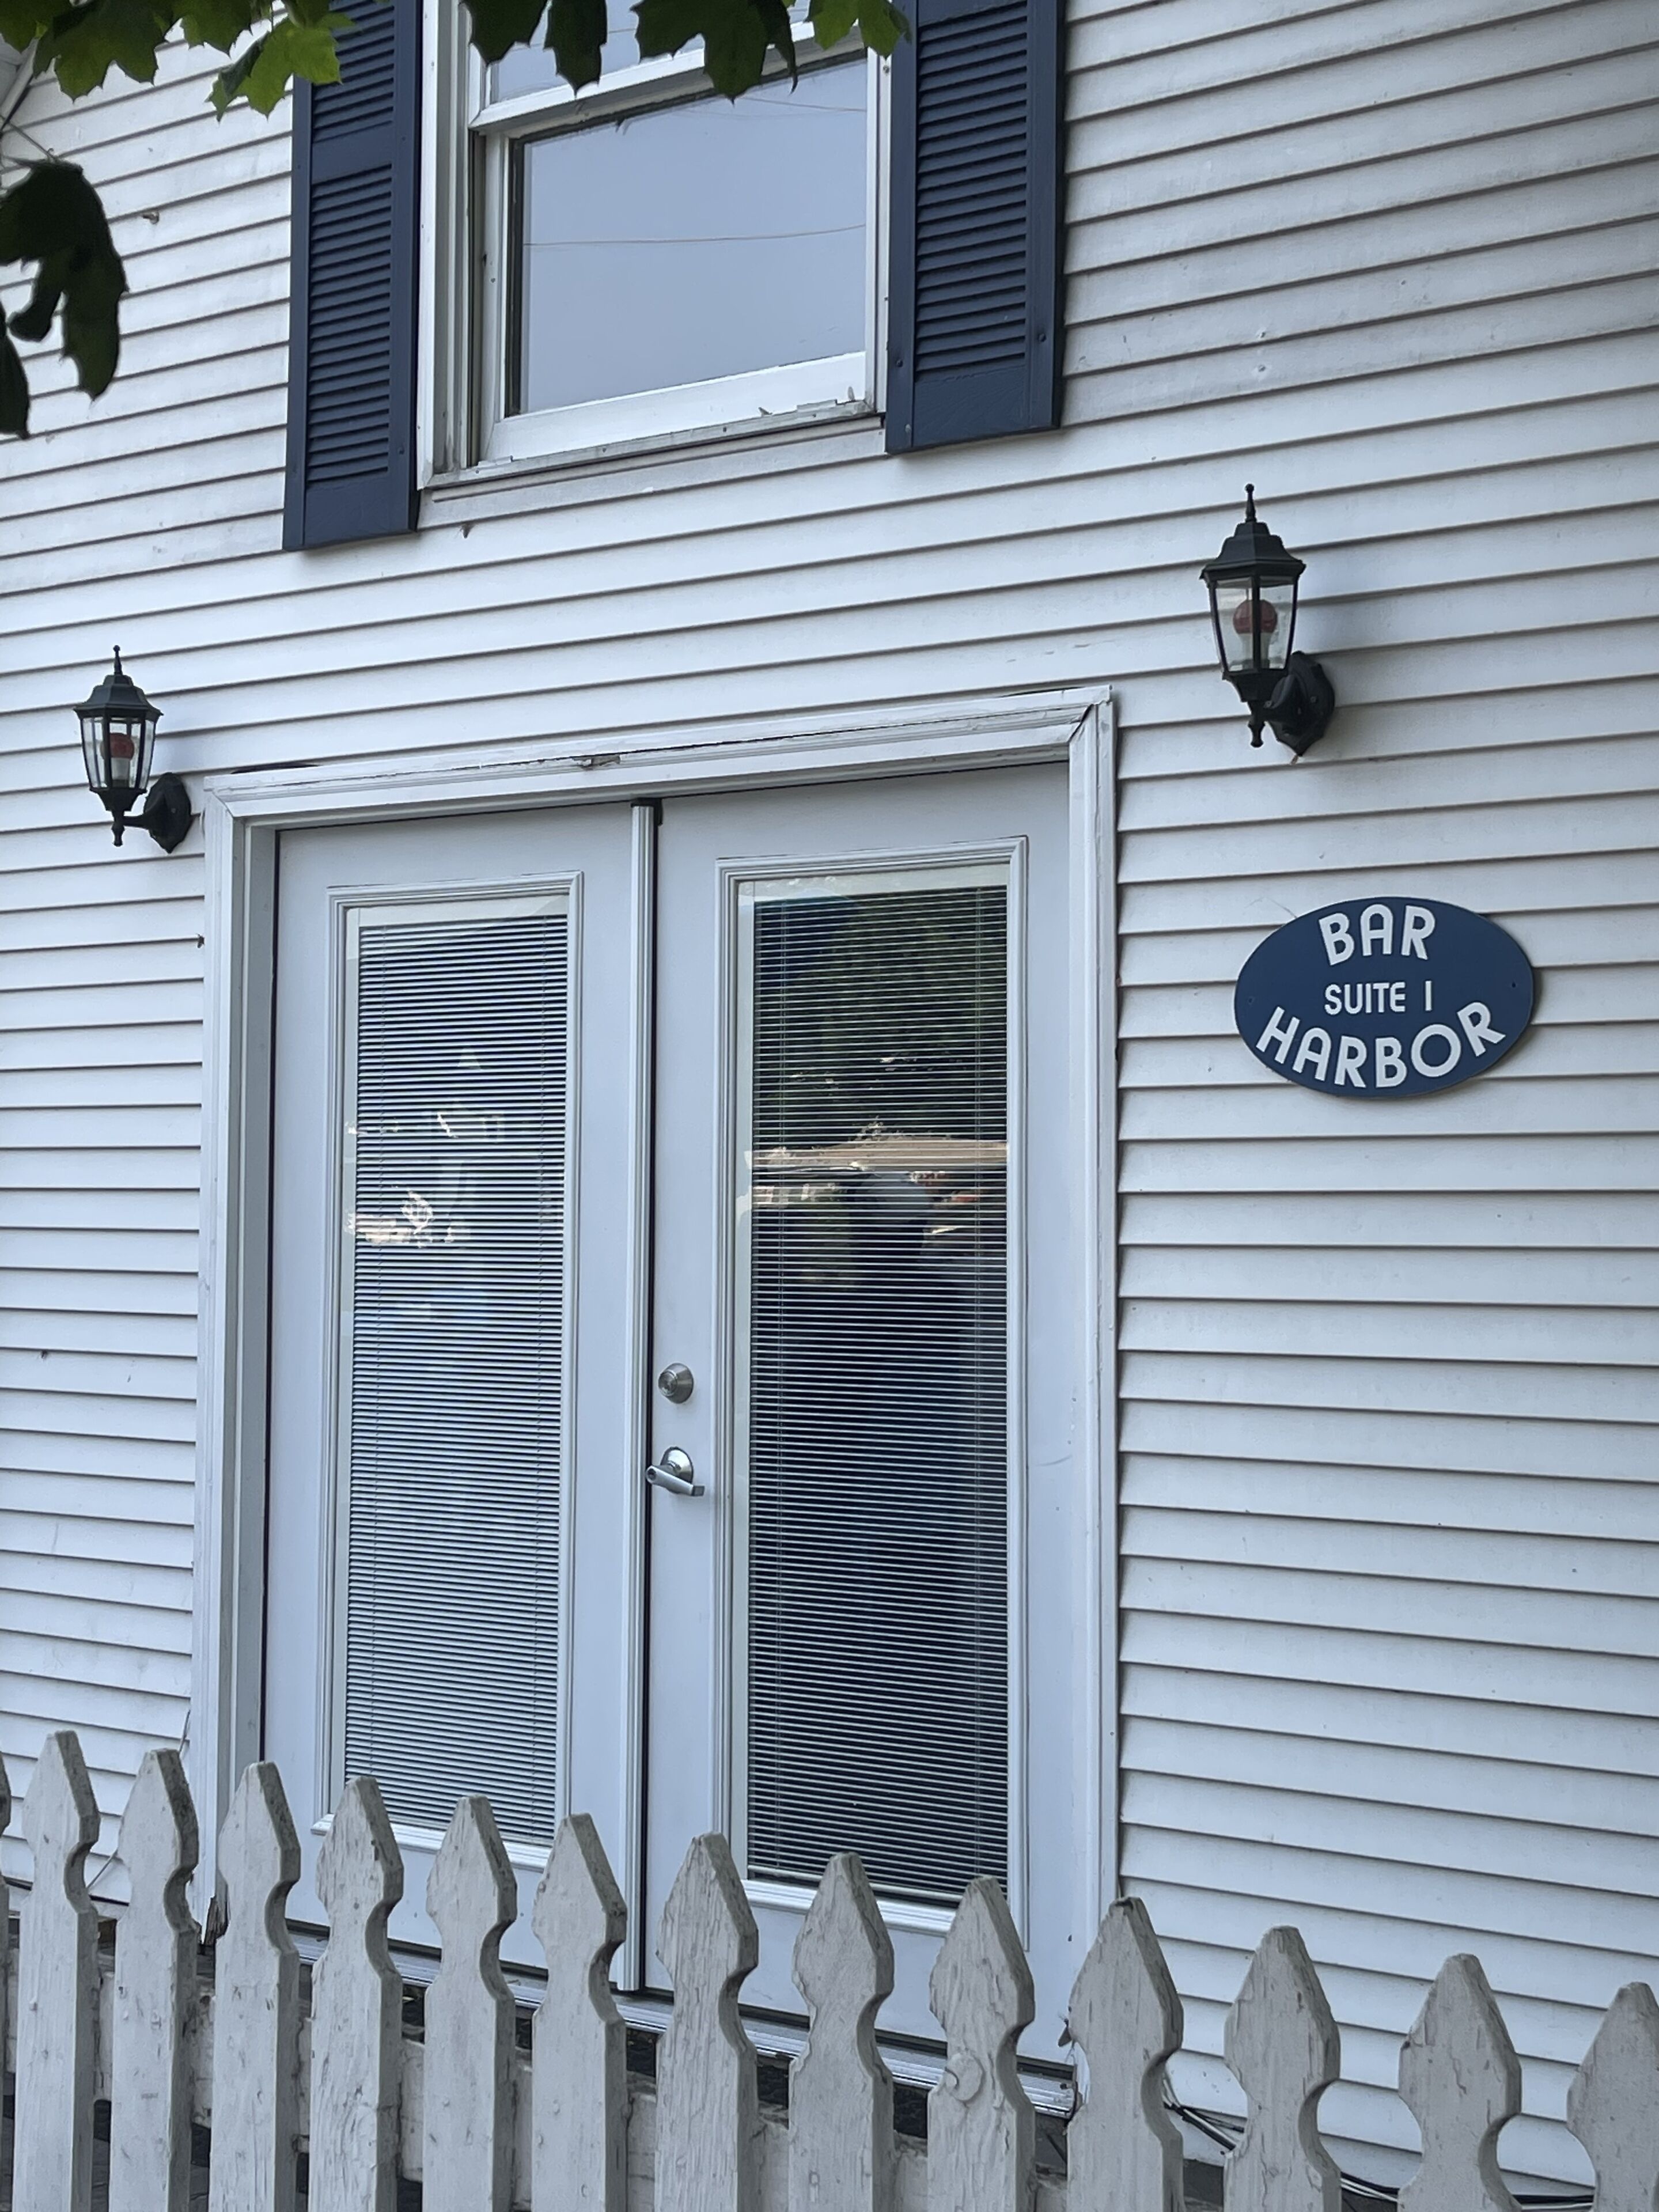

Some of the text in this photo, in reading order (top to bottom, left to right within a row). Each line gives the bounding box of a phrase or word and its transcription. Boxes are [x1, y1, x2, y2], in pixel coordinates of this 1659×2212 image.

[1319, 904, 1435, 965] BAR
[1324, 982, 1406, 1015] SUITE
[1256, 1002, 1506, 1088] HARBOR
